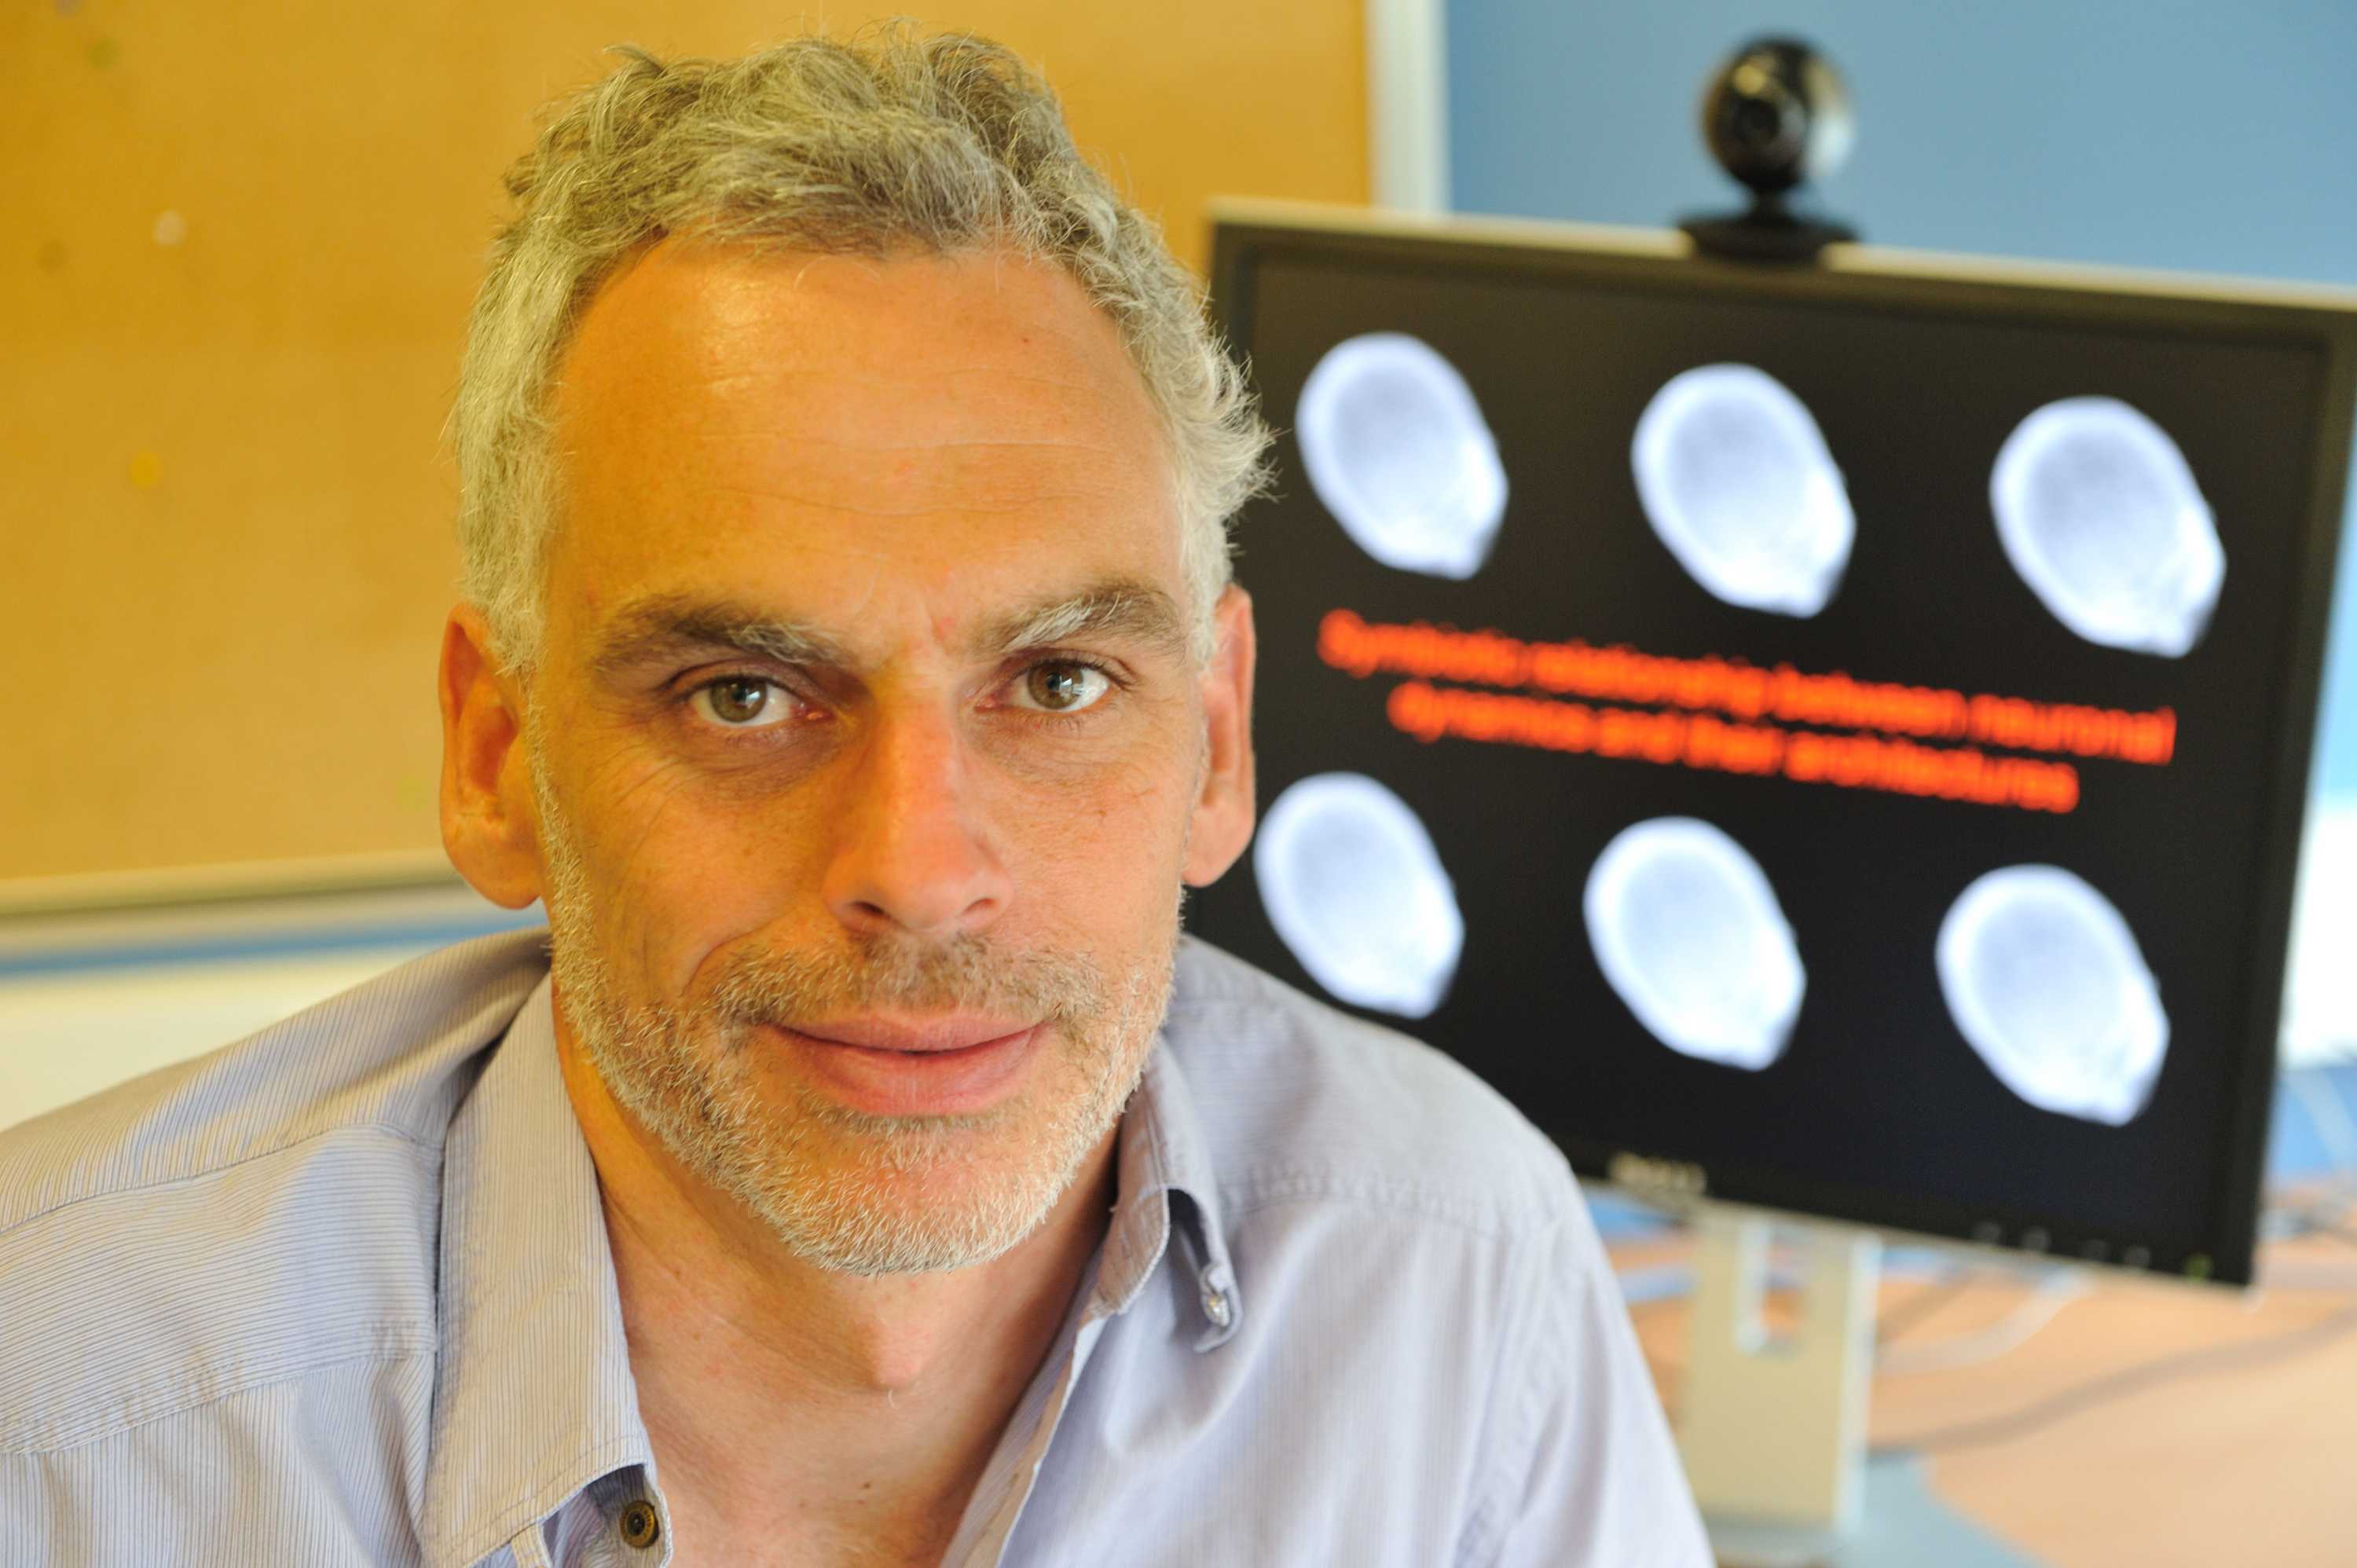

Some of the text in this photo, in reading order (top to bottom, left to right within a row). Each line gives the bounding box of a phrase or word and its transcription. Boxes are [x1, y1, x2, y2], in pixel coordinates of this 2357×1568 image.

[1595, 707, 1686, 764] and
[1769, 665, 1963, 736] between
[1967, 694, 2176, 764] neuronal
